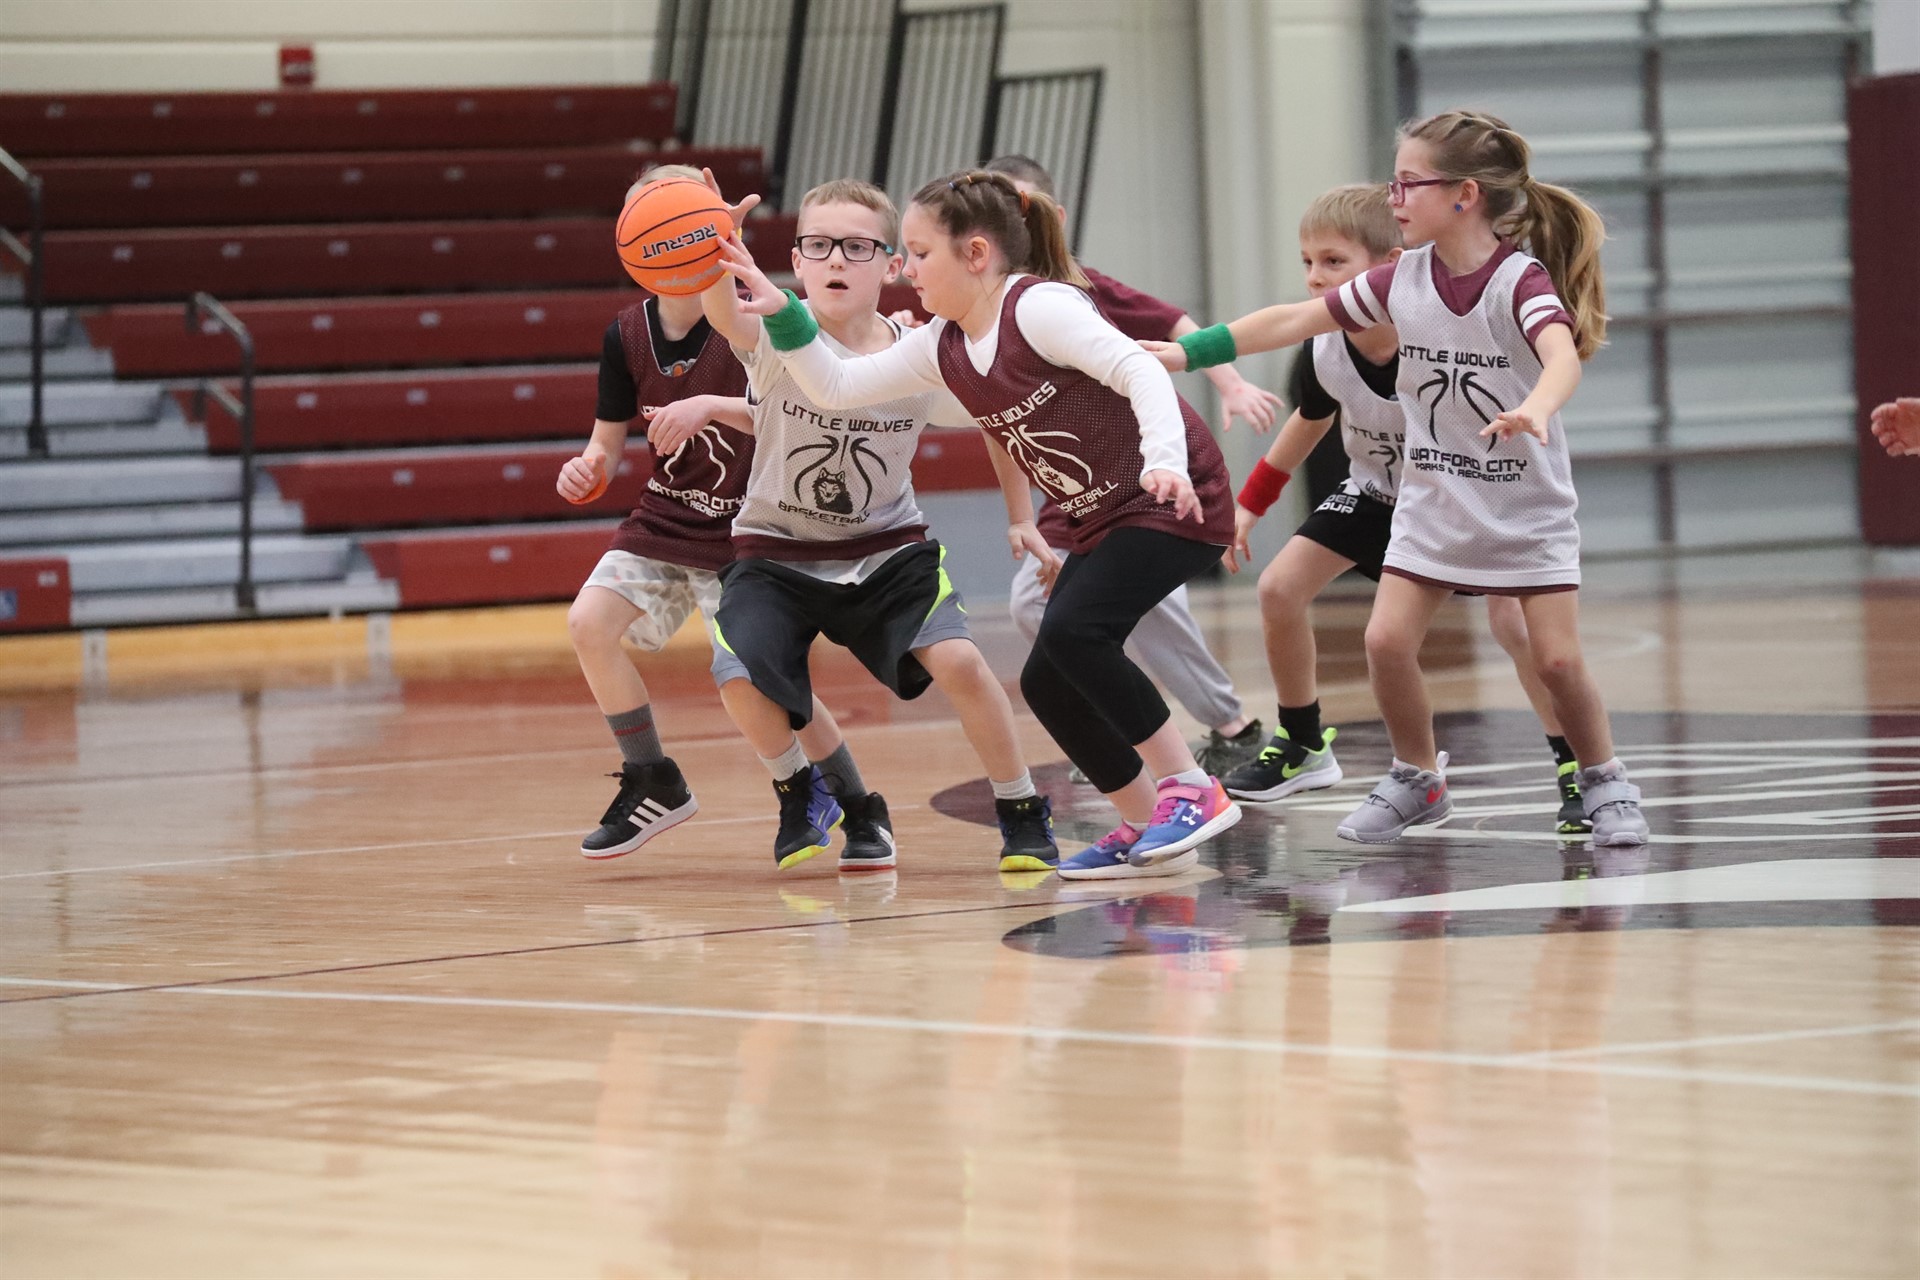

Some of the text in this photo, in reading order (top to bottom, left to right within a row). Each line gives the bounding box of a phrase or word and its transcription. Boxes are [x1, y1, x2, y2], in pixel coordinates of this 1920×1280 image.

[642, 223, 718, 259] RECRUIT
[1000, 381, 1057, 423] WOLVES
[782, 400, 914, 433] LITTLE WOLVES
[1410, 447, 1527, 473] WATFORD CITY
[1415, 462, 1445, 472] PARKS
[1457, 469, 1521, 483] RECREATION
[1057, 480, 1119, 513] SKETBALL
[1325, 494, 1359, 508] DER
[778, 500, 870, 525] BASKETBALL
[1071, 503, 1101, 519] LEAGUE
